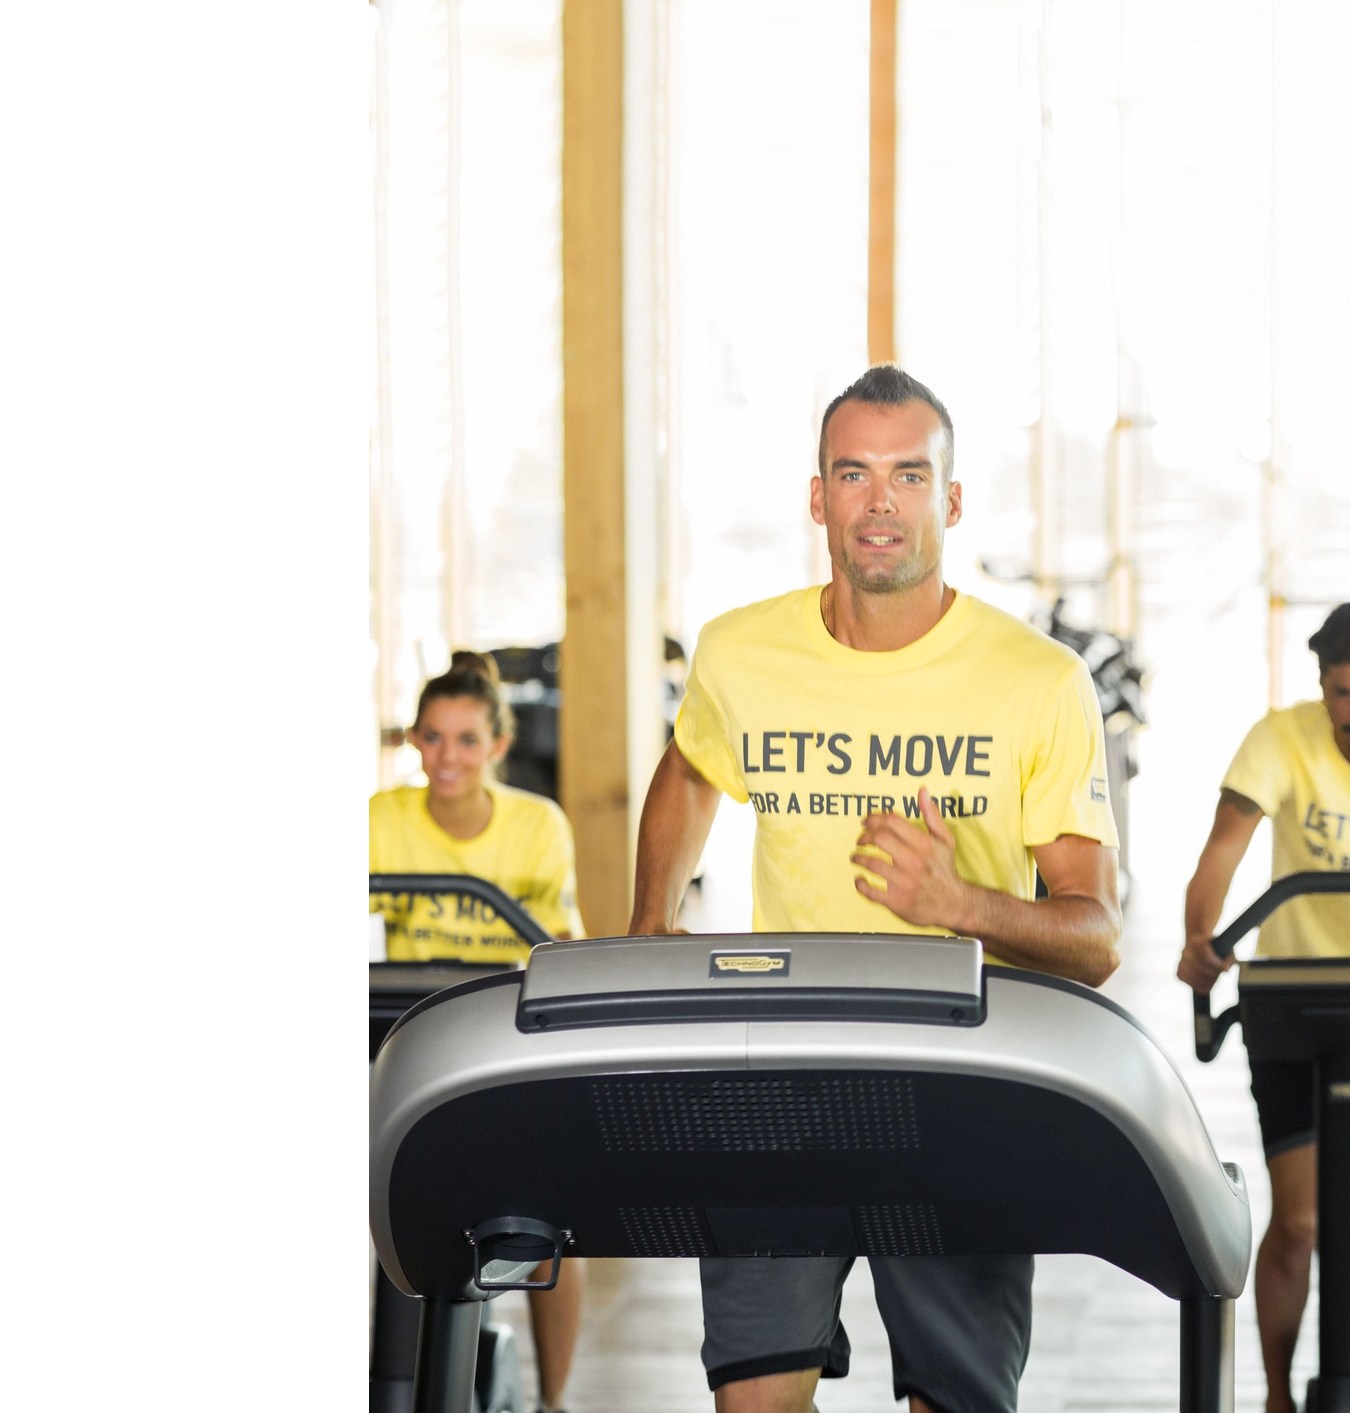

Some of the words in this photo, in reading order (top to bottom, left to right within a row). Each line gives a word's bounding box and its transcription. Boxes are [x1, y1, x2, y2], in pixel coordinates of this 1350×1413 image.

[743, 732, 852, 774] LET'S
[868, 735, 993, 777] MOVE
[787, 792, 801, 814] A
[902, 795, 988, 818] WRLD
